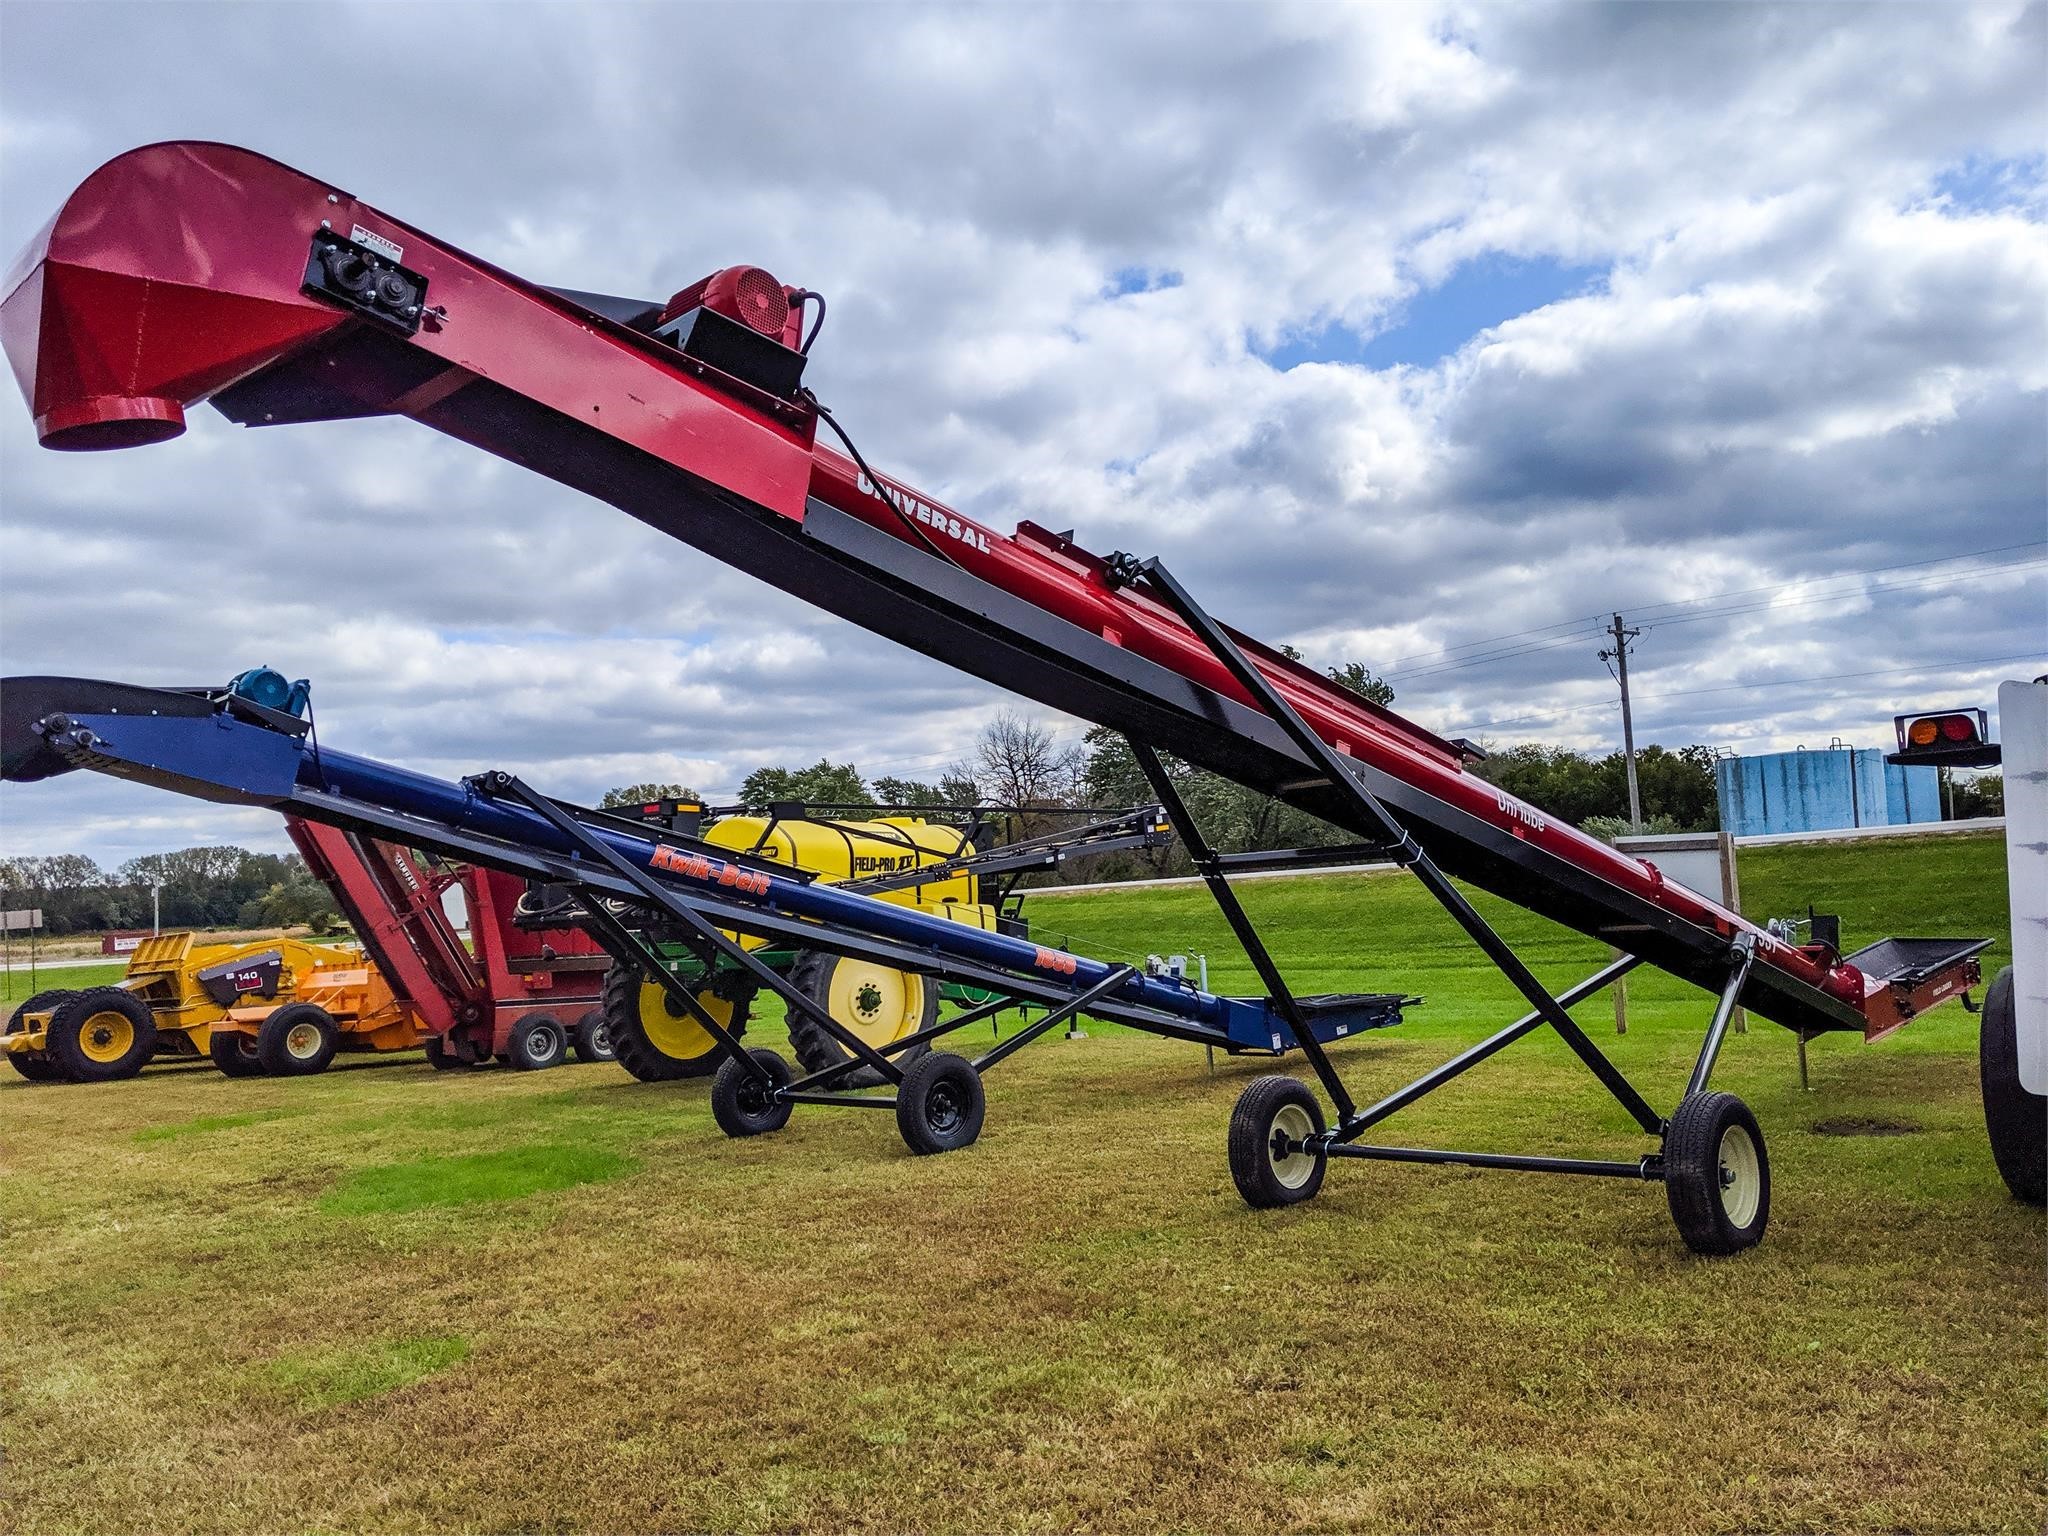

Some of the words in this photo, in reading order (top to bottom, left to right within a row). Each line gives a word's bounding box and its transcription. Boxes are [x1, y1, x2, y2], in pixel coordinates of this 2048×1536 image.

[648, 843, 772, 896] Kwik-Belt
[854, 856, 896, 872] FIELD-PRO
[238, 971, 258, 981] 140
